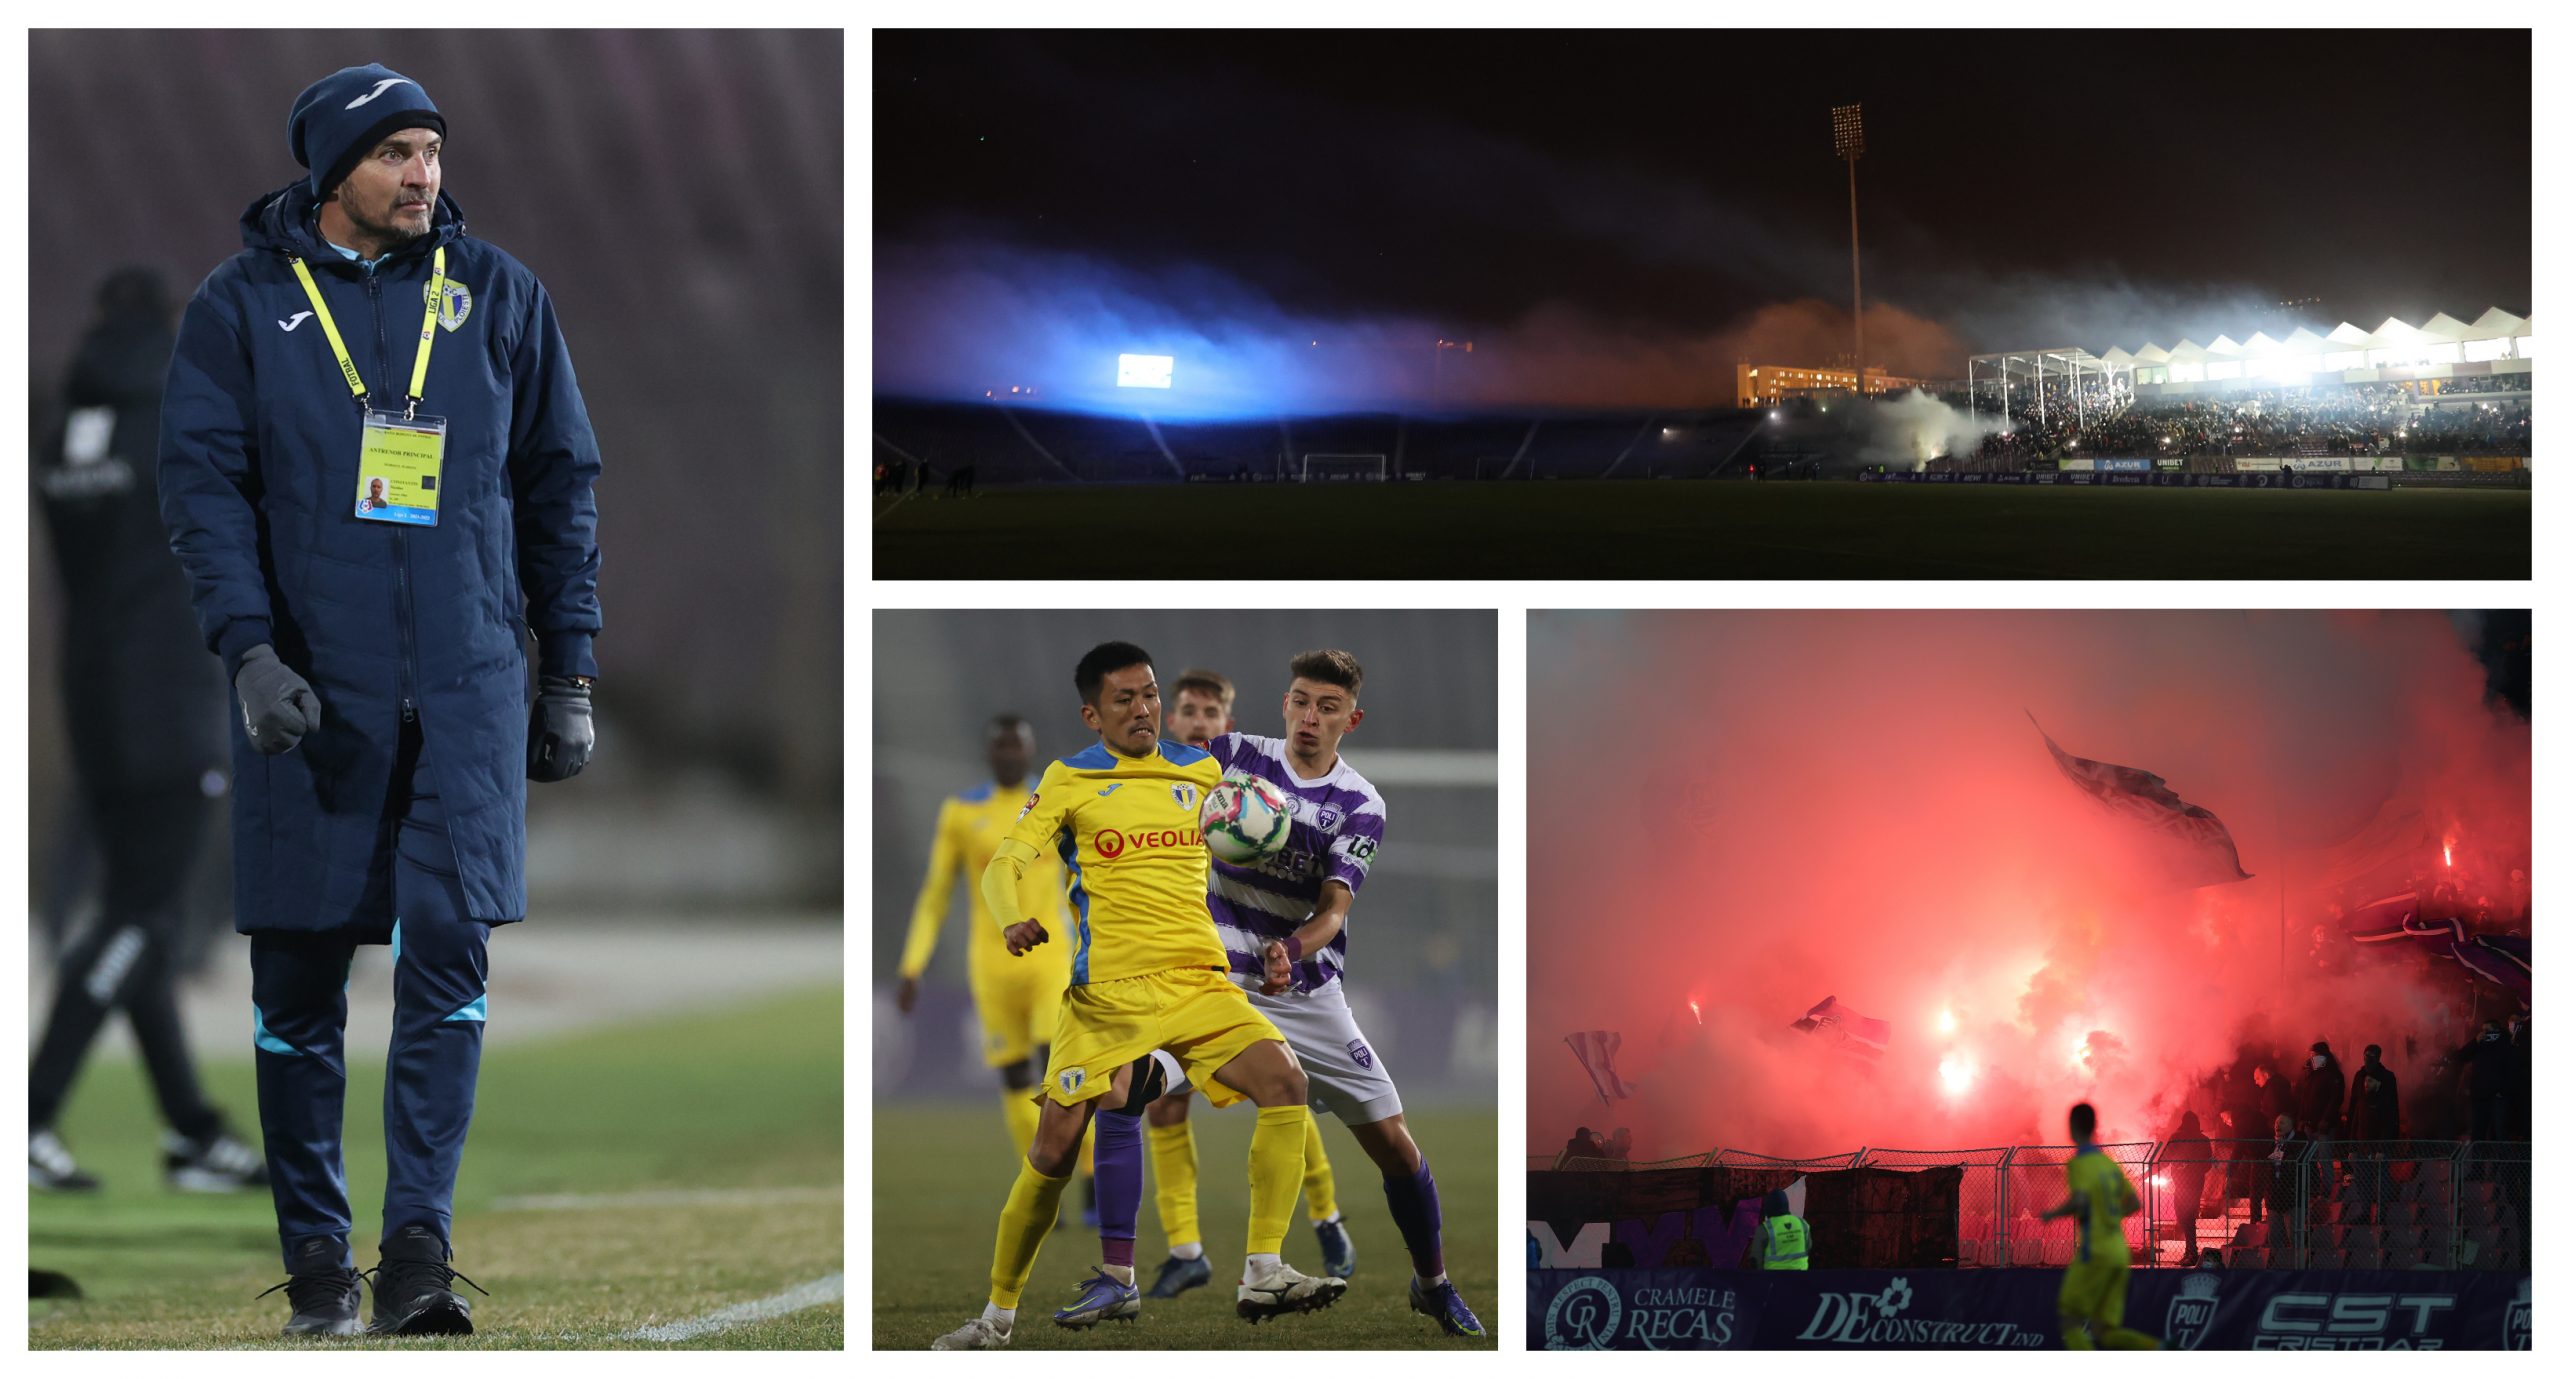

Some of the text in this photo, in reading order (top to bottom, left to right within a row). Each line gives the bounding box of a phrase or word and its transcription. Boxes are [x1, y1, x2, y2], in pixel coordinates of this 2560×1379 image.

[428, 298, 439, 314] LIGA
[341, 357, 360, 386] FOTBAL
[2157, 458, 2184, 466] UNIBET
[1320, 810, 1336, 821] POLI
[1128, 830, 1205, 849] VEOLIA
[1353, 1047, 1368, 1060] POLI
[1360, 1057, 1369, 1066] T
[1552, 1278, 1593, 1309] RESPECT
[1596, 1280, 1620, 1318] PENTRU
[1634, 1287, 1736, 1310] CRAMELE
[2175, 1303, 2209, 1325] POLI
[2259, 1293, 2456, 1335] CST
[2512, 1308, 2532, 1329] PO
[1600, 1322, 1617, 1339] VIN
[2010, 1332, 2045, 1347] IND
[2177, 1328, 2195, 1349] T
